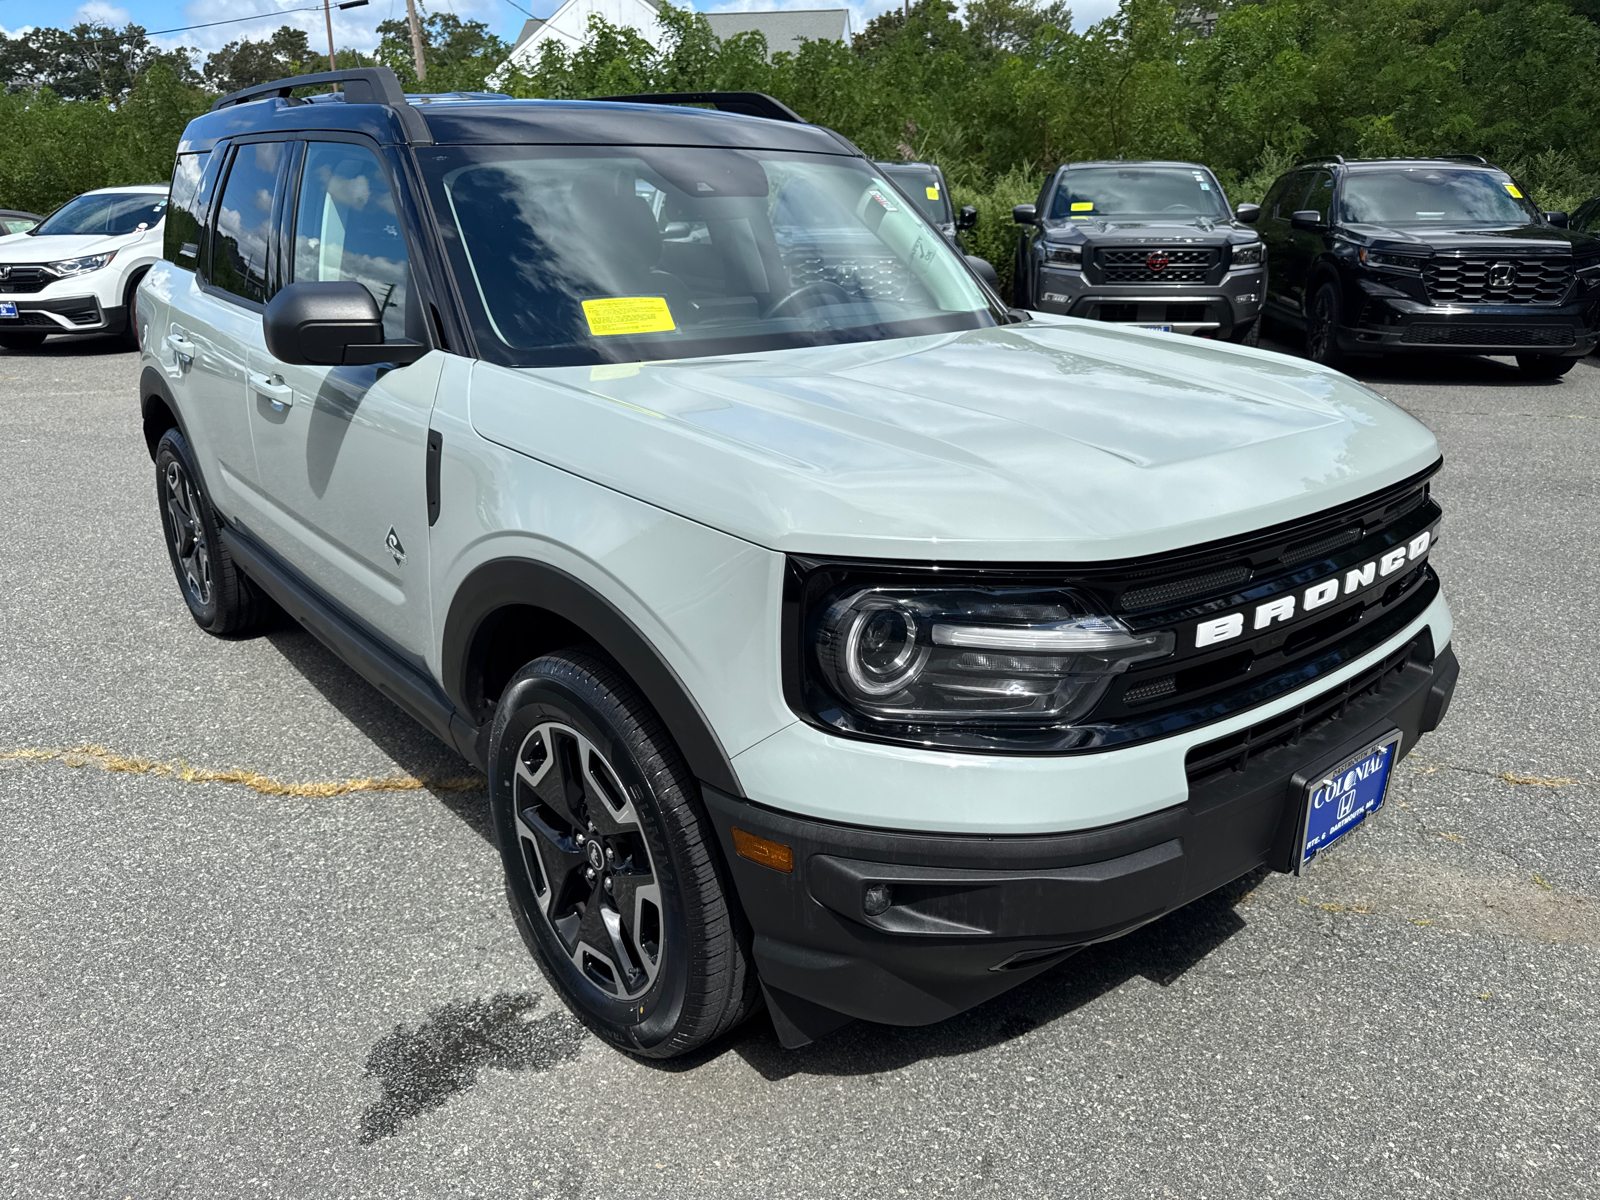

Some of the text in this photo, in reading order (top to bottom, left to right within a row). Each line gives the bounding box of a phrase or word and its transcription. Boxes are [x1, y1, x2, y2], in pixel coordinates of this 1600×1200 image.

[1194, 531, 1430, 648] BRONCO
[1314, 757, 1383, 809] COLONIAL
[1321, 832, 1327, 840] 6
[1365, 799, 1374, 809] MA
[629, 783, 679, 912] SUMMIT
